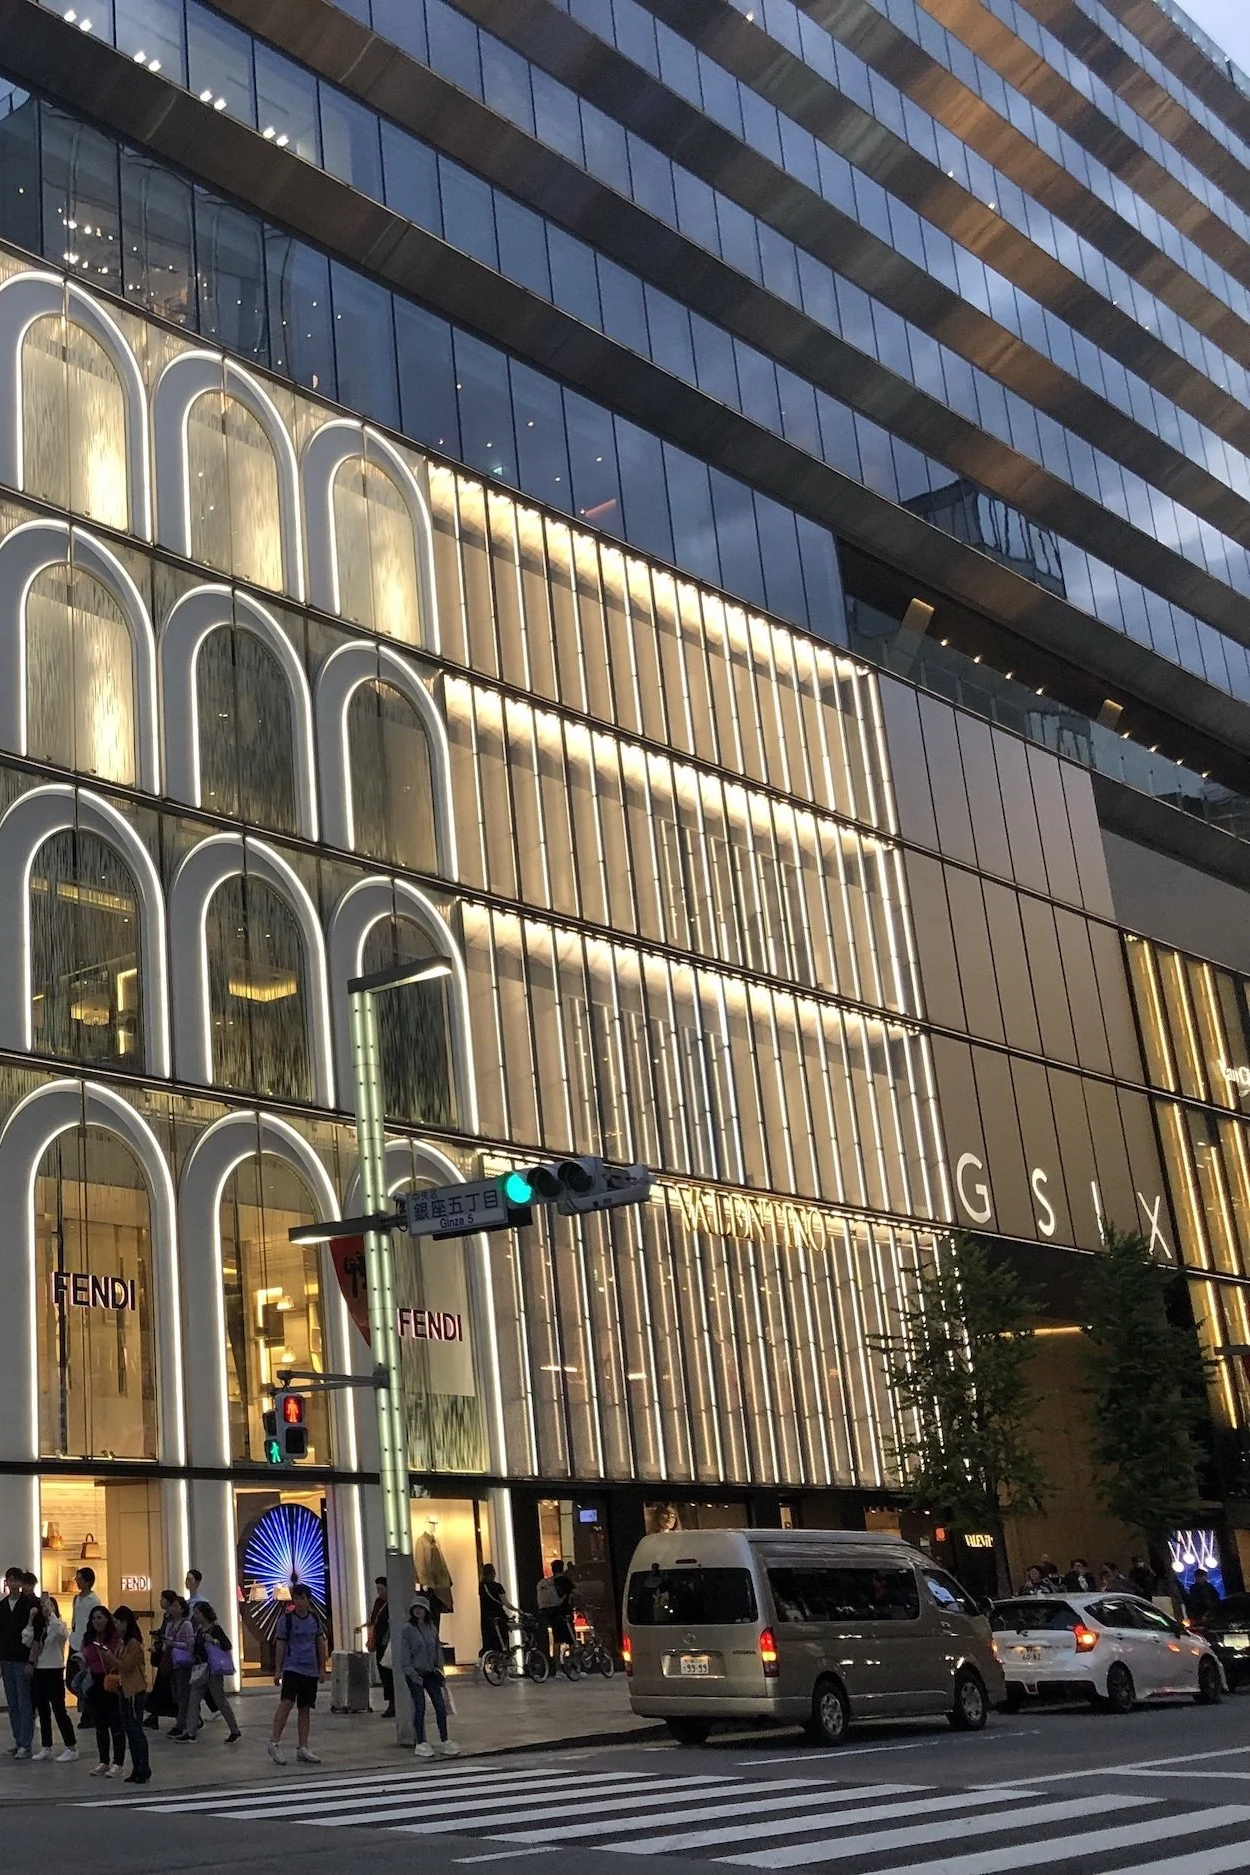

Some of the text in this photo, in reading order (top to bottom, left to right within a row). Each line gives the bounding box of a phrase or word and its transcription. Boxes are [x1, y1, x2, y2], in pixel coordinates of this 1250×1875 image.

[413, 1189, 499, 1221] 銀座五丁目
[674, 1183, 828, 1252] VALENTINO
[440, 1214, 475, 1229] Ginza 5
[52, 1271, 135, 1311] FENDI
[397, 1308, 463, 1341] FENDI
[120, 1576, 151, 1592] FENDI
